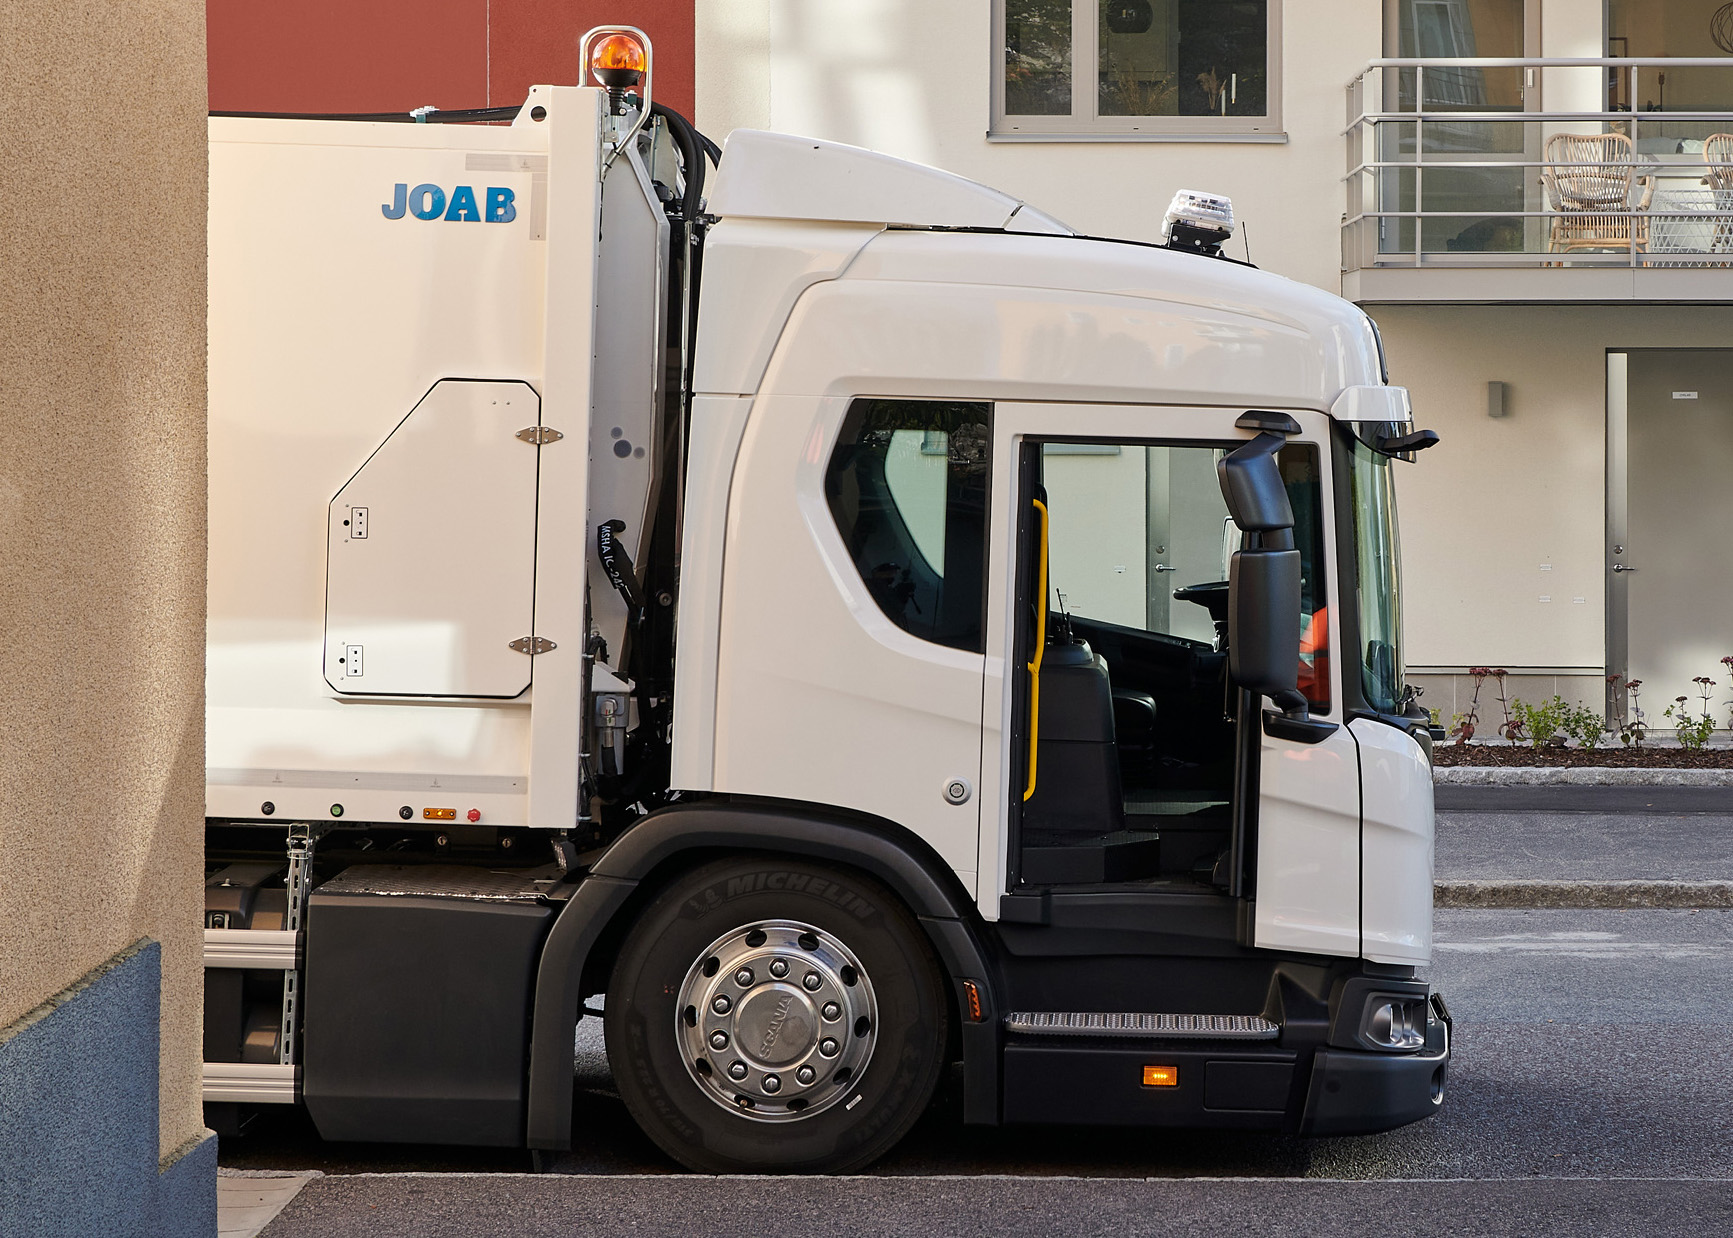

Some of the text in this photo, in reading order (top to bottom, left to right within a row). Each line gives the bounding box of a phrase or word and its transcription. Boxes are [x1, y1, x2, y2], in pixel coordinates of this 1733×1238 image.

[382, 183, 517, 223] JOAB
[601, 525, 611, 554] MSHA
[727, 871, 877, 920] MICHELIN
[759, 995, 794, 1059] SCANIA
